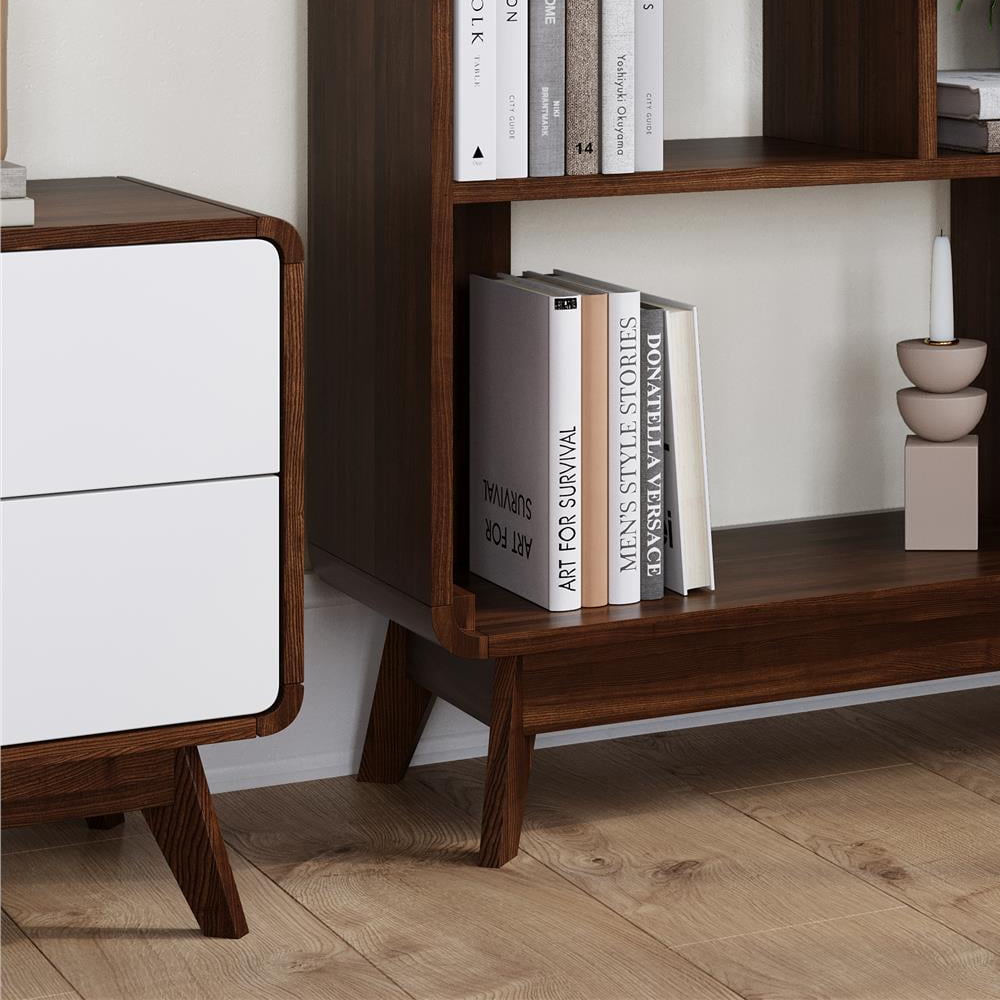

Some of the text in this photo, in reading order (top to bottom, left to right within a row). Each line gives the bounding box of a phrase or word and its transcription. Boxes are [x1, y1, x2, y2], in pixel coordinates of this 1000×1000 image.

[473, 56, 481, 88] TABLE
[508, 94, 516, 140] CITY GUIDE
[541, 86, 549, 137] BRANTMARK
[614, 54, 626, 157] Yoshiyuki Okuyama
[575, 142, 594, 155] 14
[619, 316, 637, 573] MEN'S STYLE STORIES
[646, 333, 662, 577] DONATELLA VERSACE
[483, 479, 532, 520] SURVIVAL
[559, 425, 576, 592] ART FOR SURVIVAL
[485, 518, 532, 559] ART FOR
